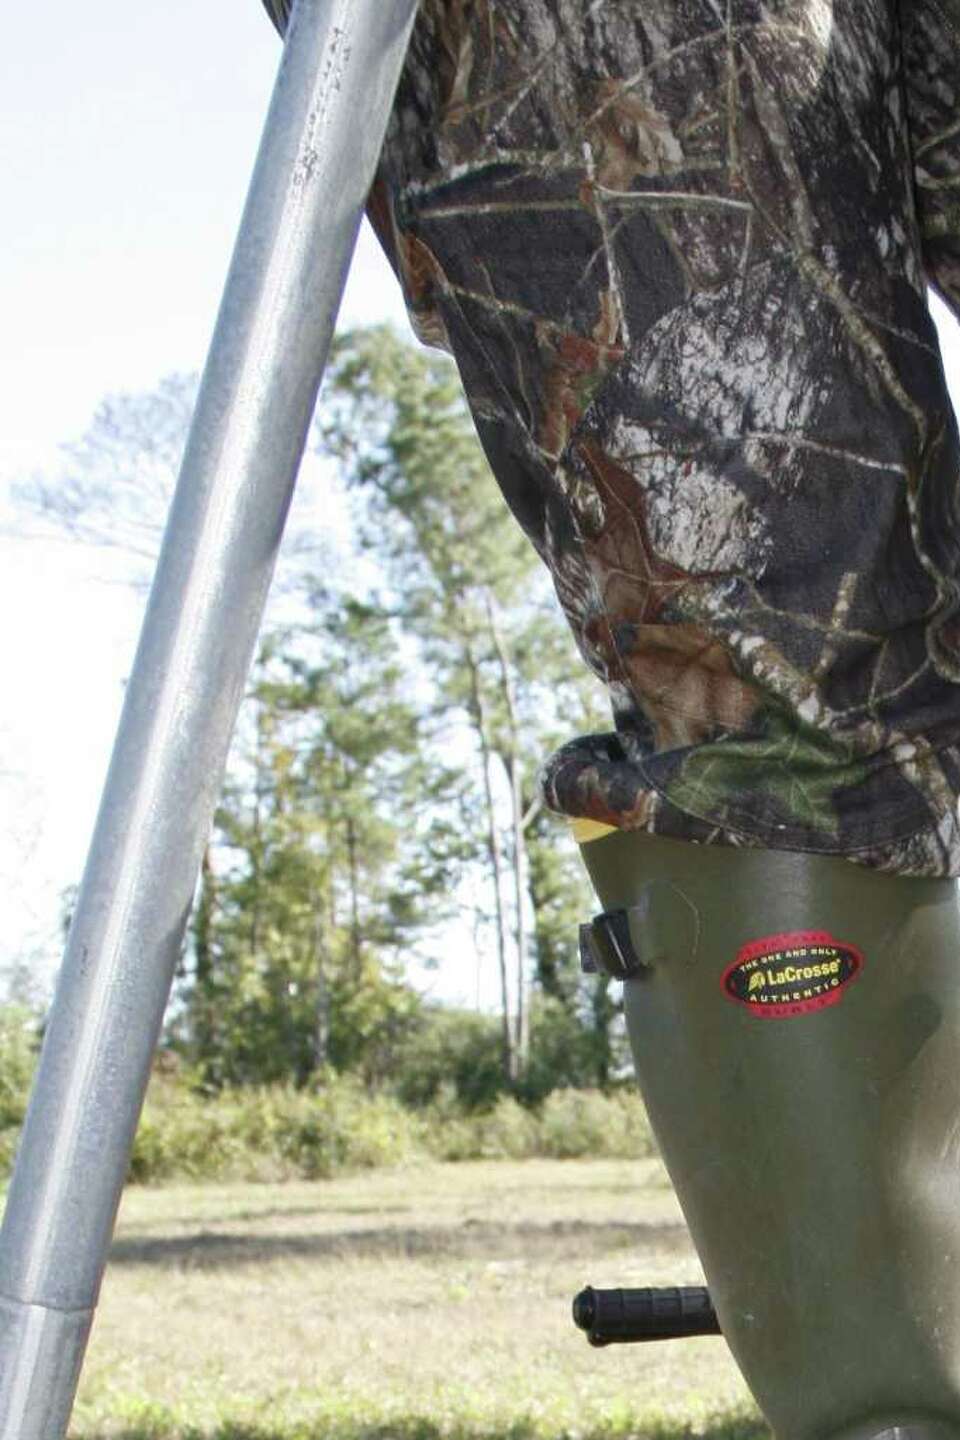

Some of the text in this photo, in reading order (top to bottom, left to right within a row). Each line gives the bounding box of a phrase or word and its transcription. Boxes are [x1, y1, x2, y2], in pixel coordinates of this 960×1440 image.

[739, 960, 759, 972] THE
[767, 961, 840, 986] LaCrosse
[750, 978, 840, 1002] AUTHENTIC
